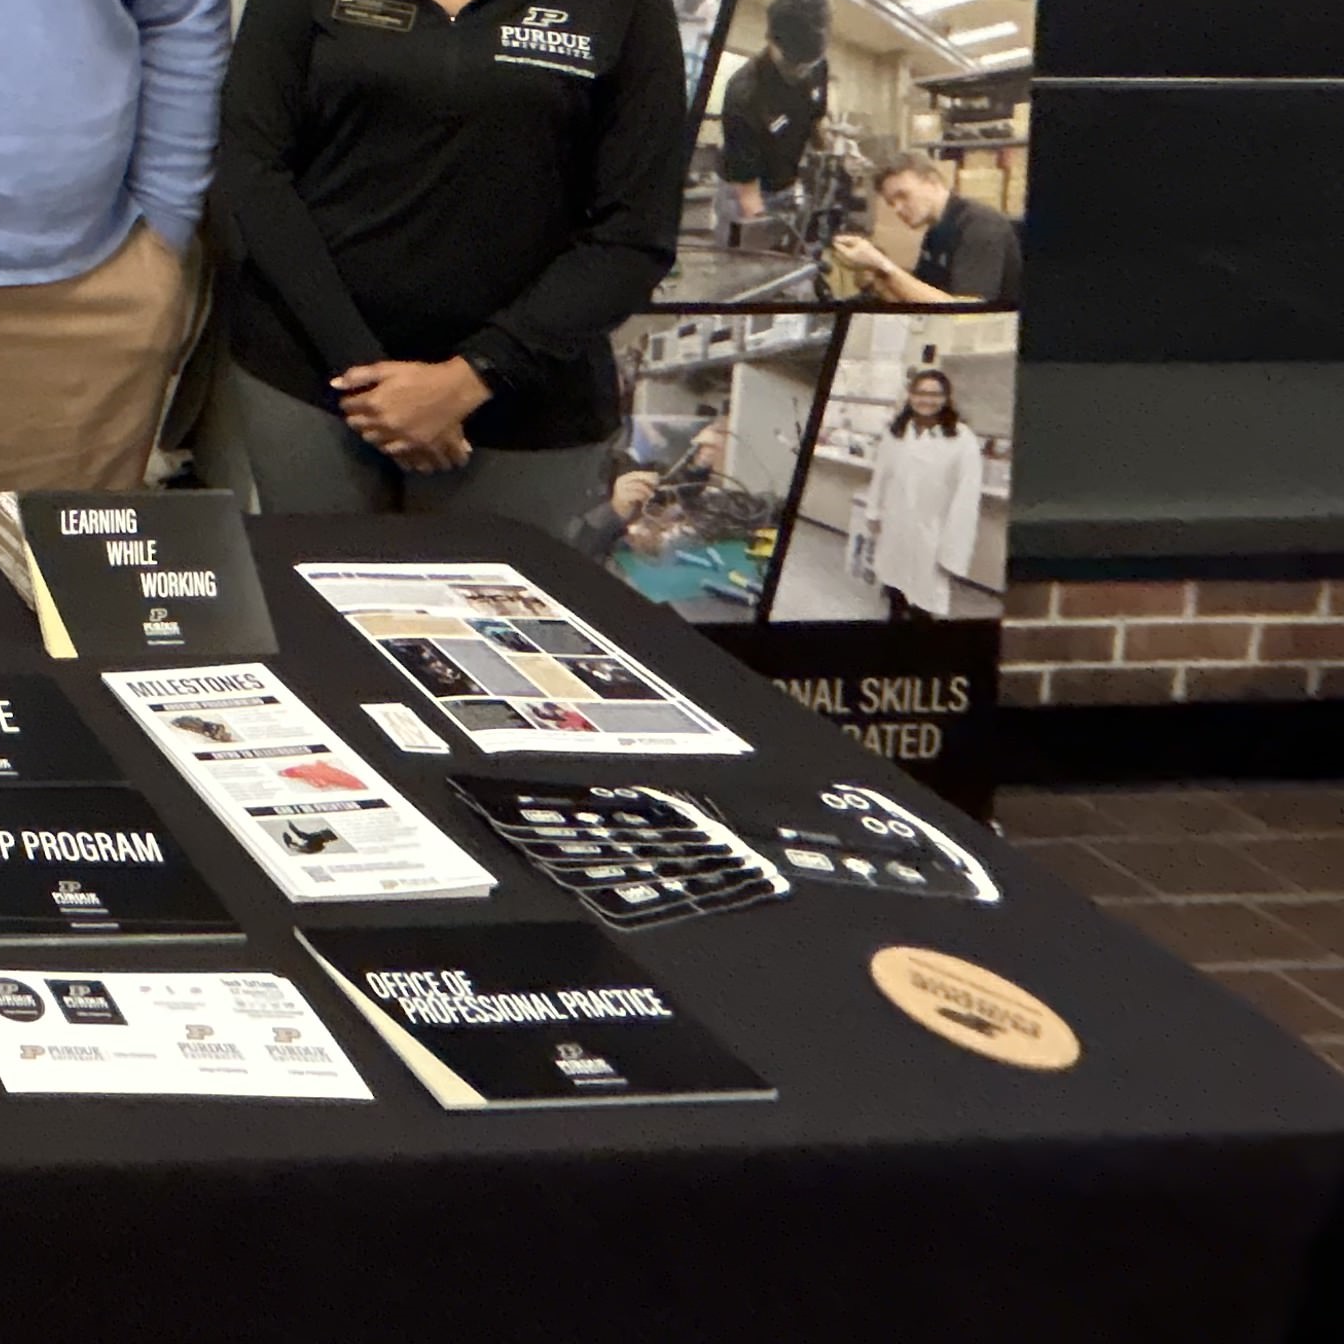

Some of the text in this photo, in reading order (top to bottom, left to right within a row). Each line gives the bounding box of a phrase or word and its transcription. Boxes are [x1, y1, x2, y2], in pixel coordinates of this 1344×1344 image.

[501, 26, 591, 51] PURDUE
[60, 509, 137, 536] LEARNING
[106, 540, 157, 566] WHILE
[140, 571, 217, 598] WORKING
[126, 673, 265, 700] MILESTONES
[773, 675, 971, 714] NAL SKILLS
[842, 722, 943, 759] ATED
[22, 830, 165, 864] PROGRAM
[365, 970, 476, 1001] OFFICE OF
[398, 987, 673, 1025] PROFESSIONAL PRACTICE
